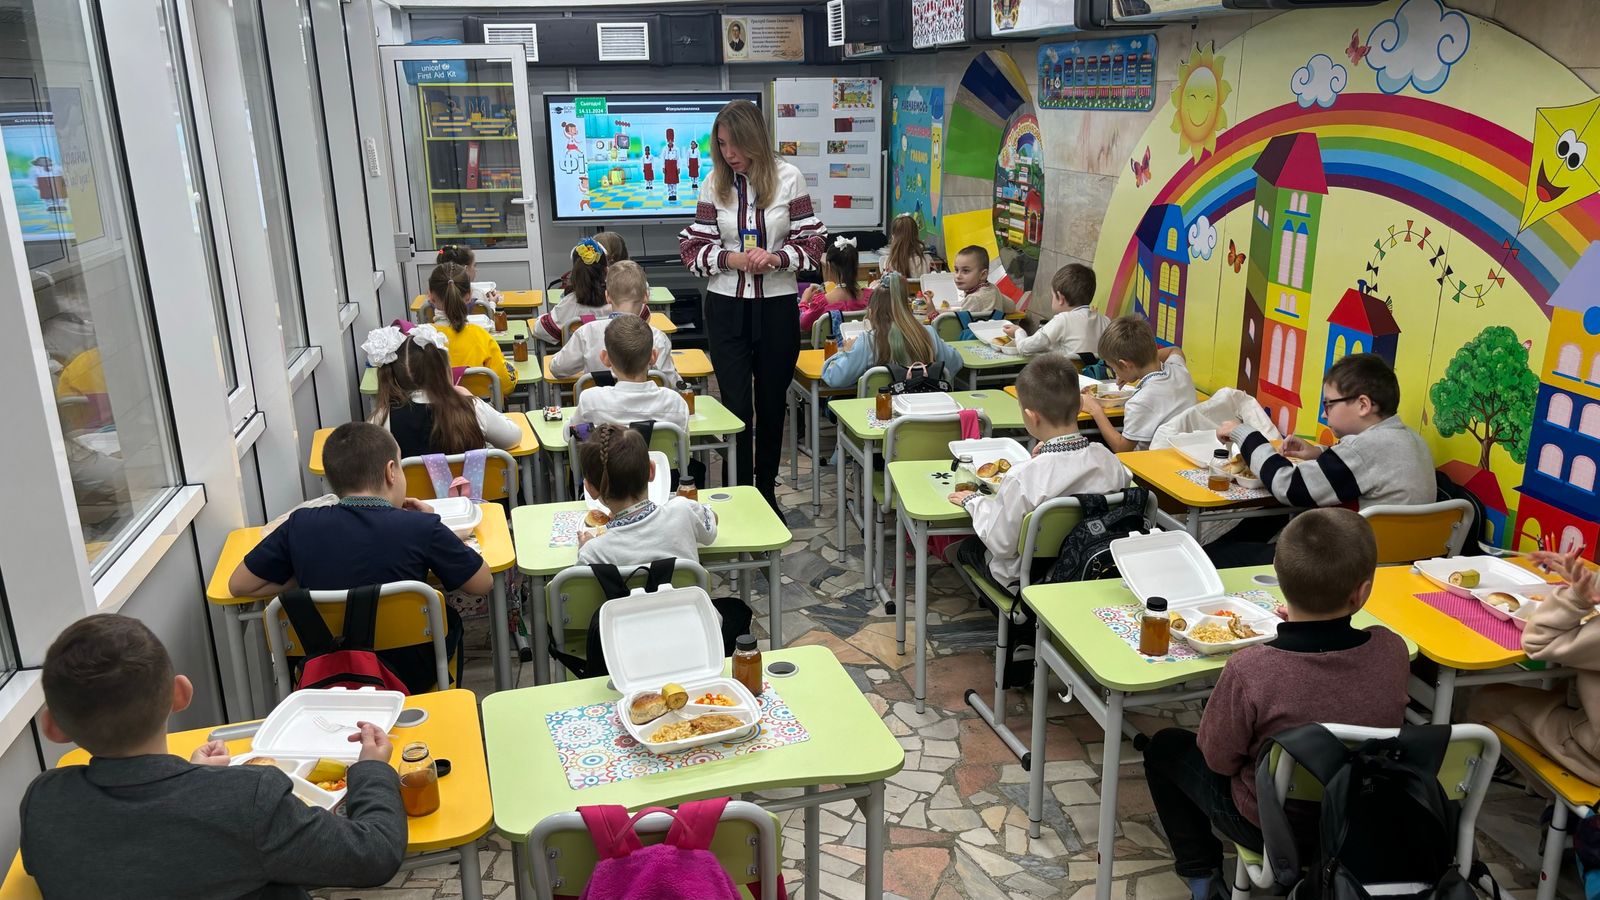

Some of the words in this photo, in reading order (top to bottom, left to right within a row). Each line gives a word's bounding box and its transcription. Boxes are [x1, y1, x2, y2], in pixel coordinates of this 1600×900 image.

[421, 63, 440, 71] unicef
[417, 72, 432, 80] First
[434, 71, 445, 79] Aid
[447, 70, 456, 78] Kit
